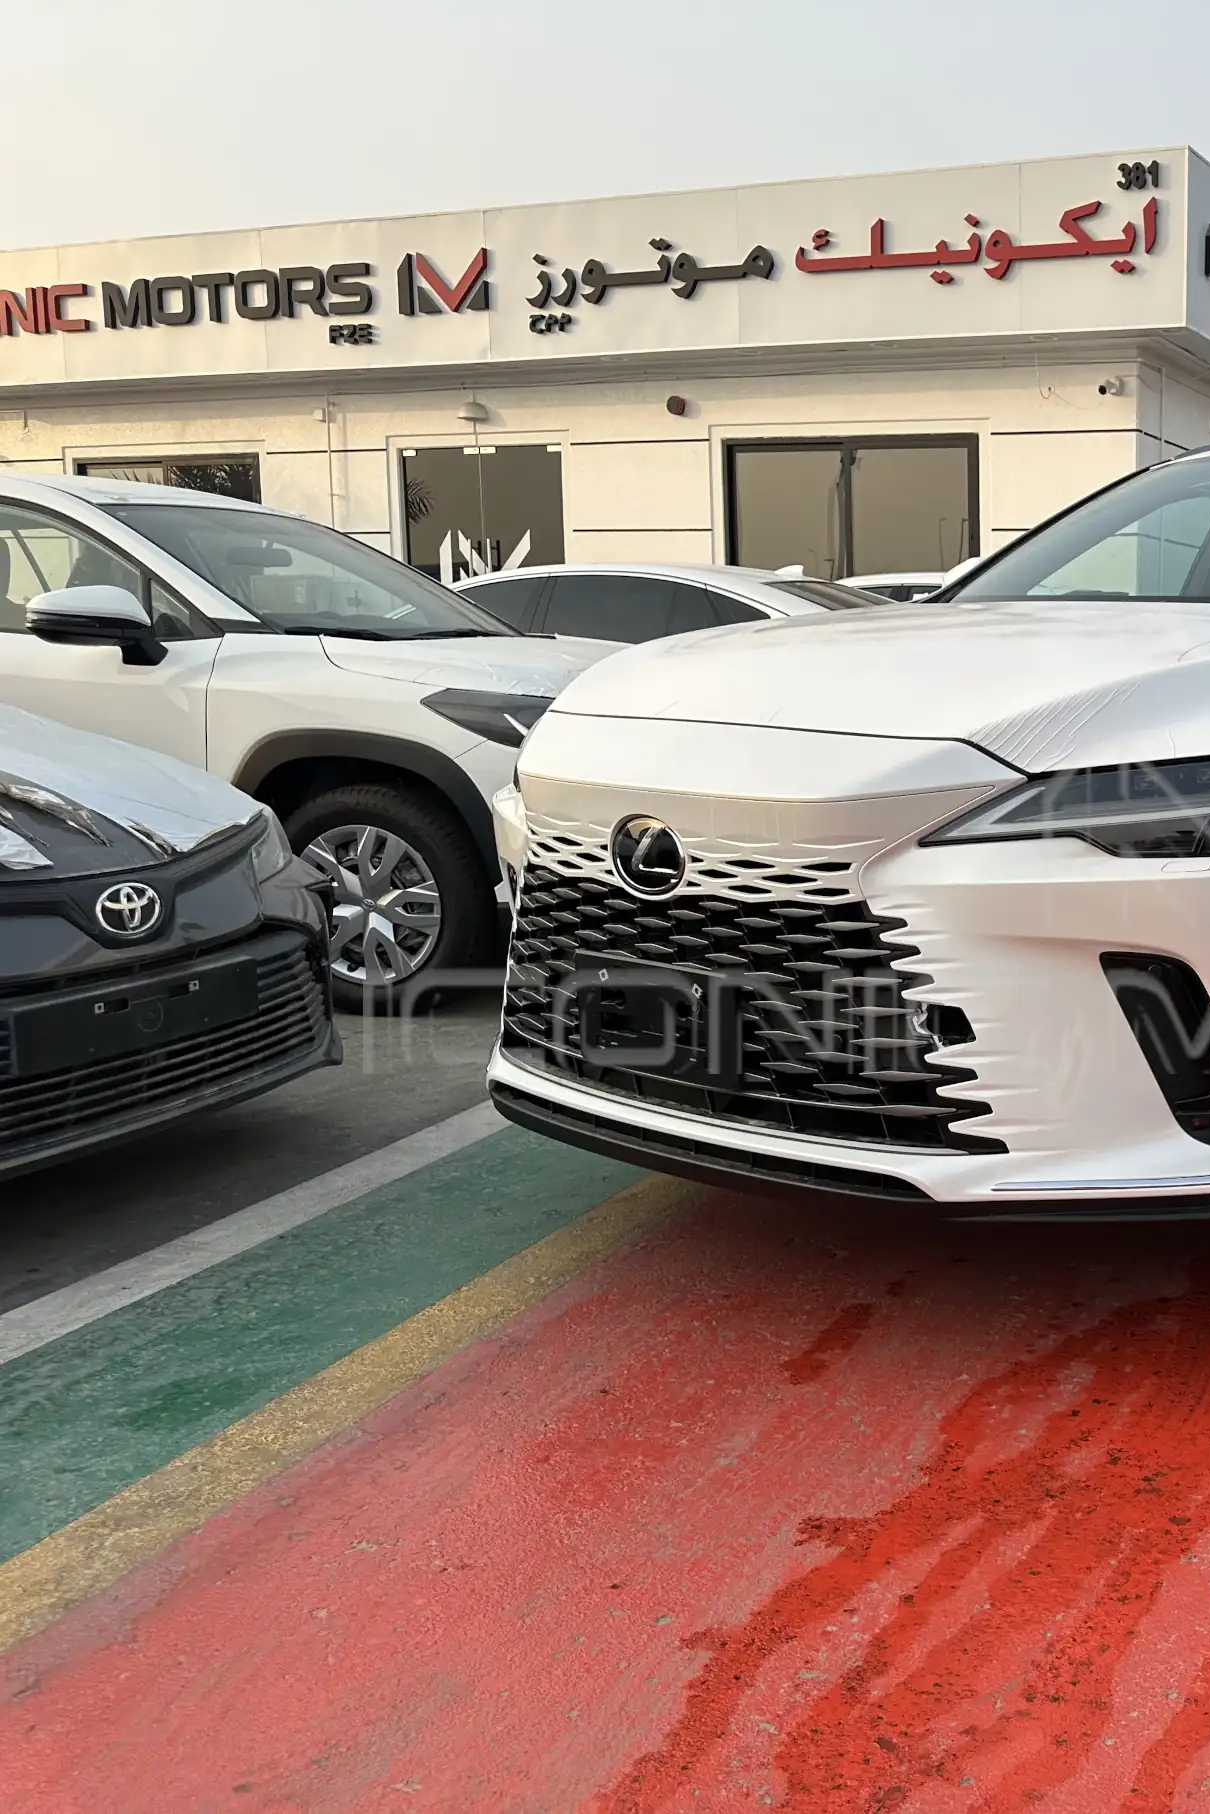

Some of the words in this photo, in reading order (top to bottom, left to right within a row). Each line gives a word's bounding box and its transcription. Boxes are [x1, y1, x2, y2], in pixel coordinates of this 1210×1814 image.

[1117, 160, 1160, 191] 381
[101, 262, 373, 331] MOTORS
[525, 237, 775, 309] موتورز
